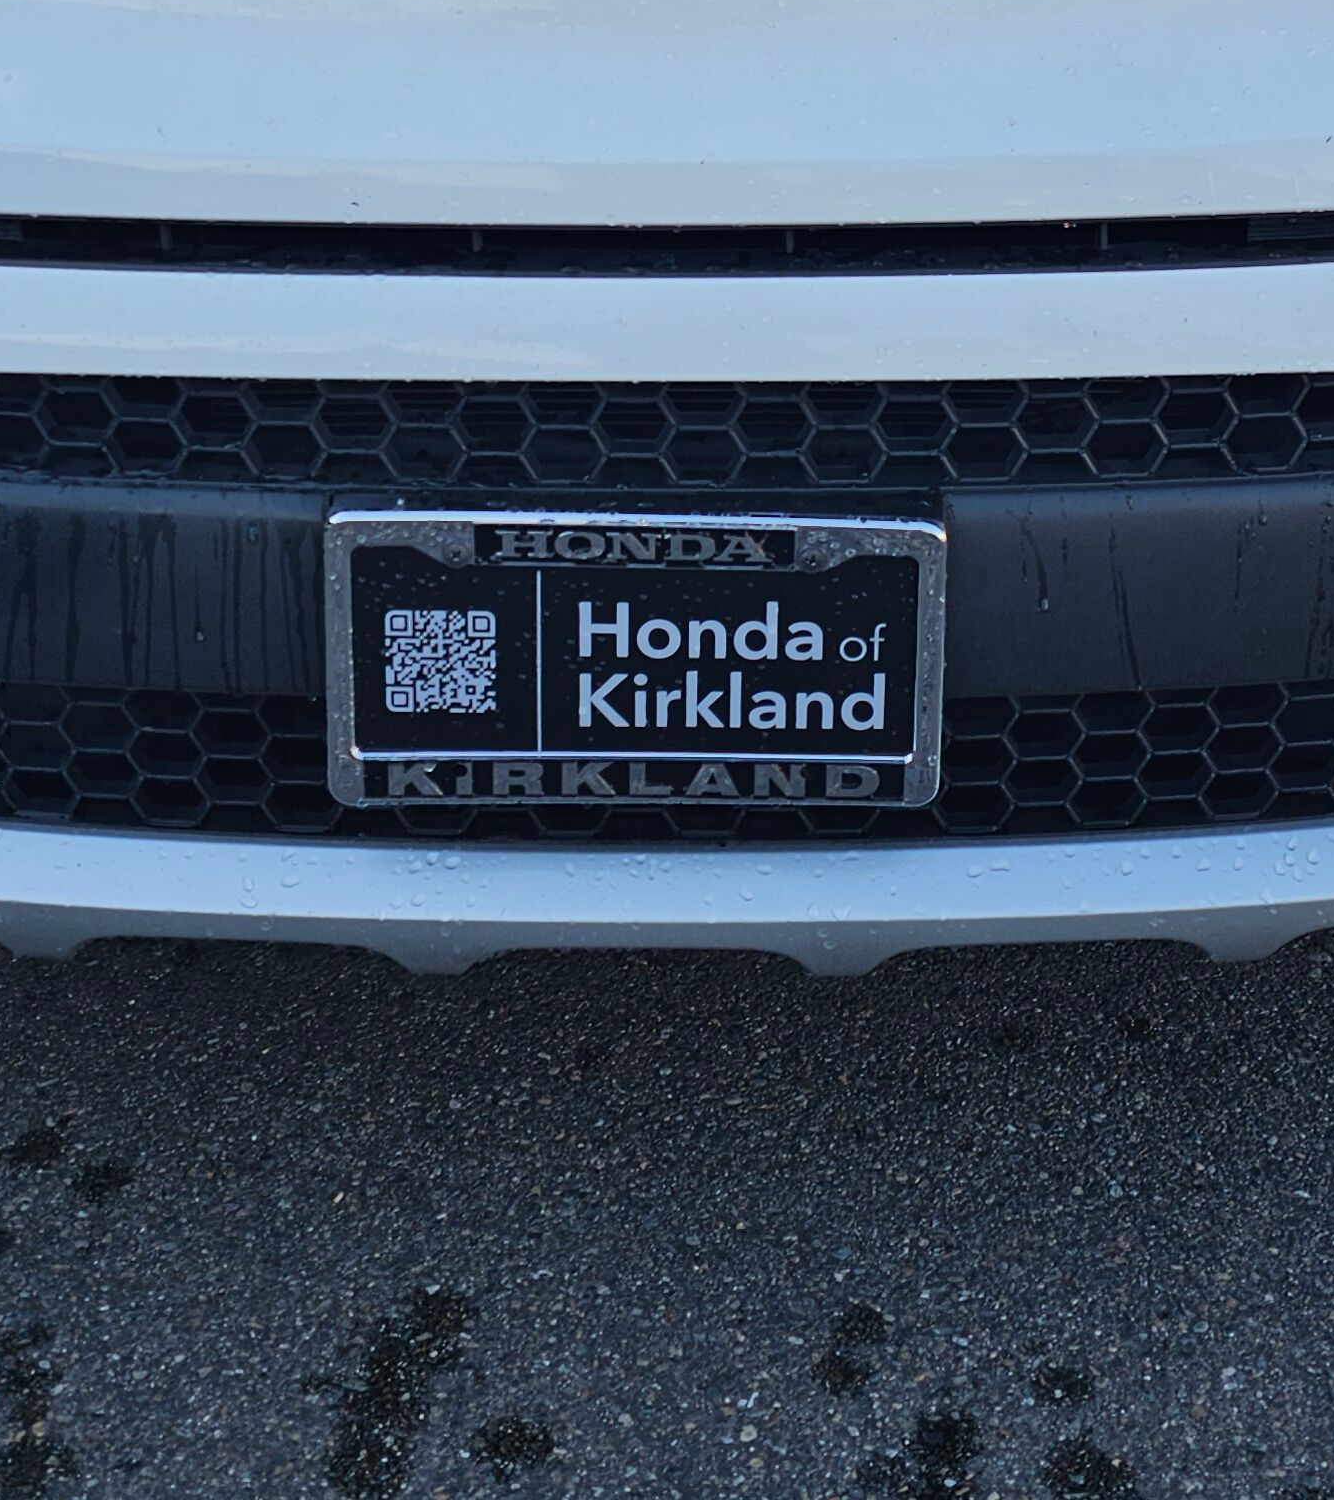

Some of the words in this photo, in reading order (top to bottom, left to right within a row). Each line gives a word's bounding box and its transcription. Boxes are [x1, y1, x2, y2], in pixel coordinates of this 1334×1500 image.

[492, 528, 773, 565] HONDA
[578, 600, 825, 662] Honda
[838, 621, 887, 663] of
[577, 670, 887, 731] Kirkland
[385, 761, 882, 800] KIRKLAND
